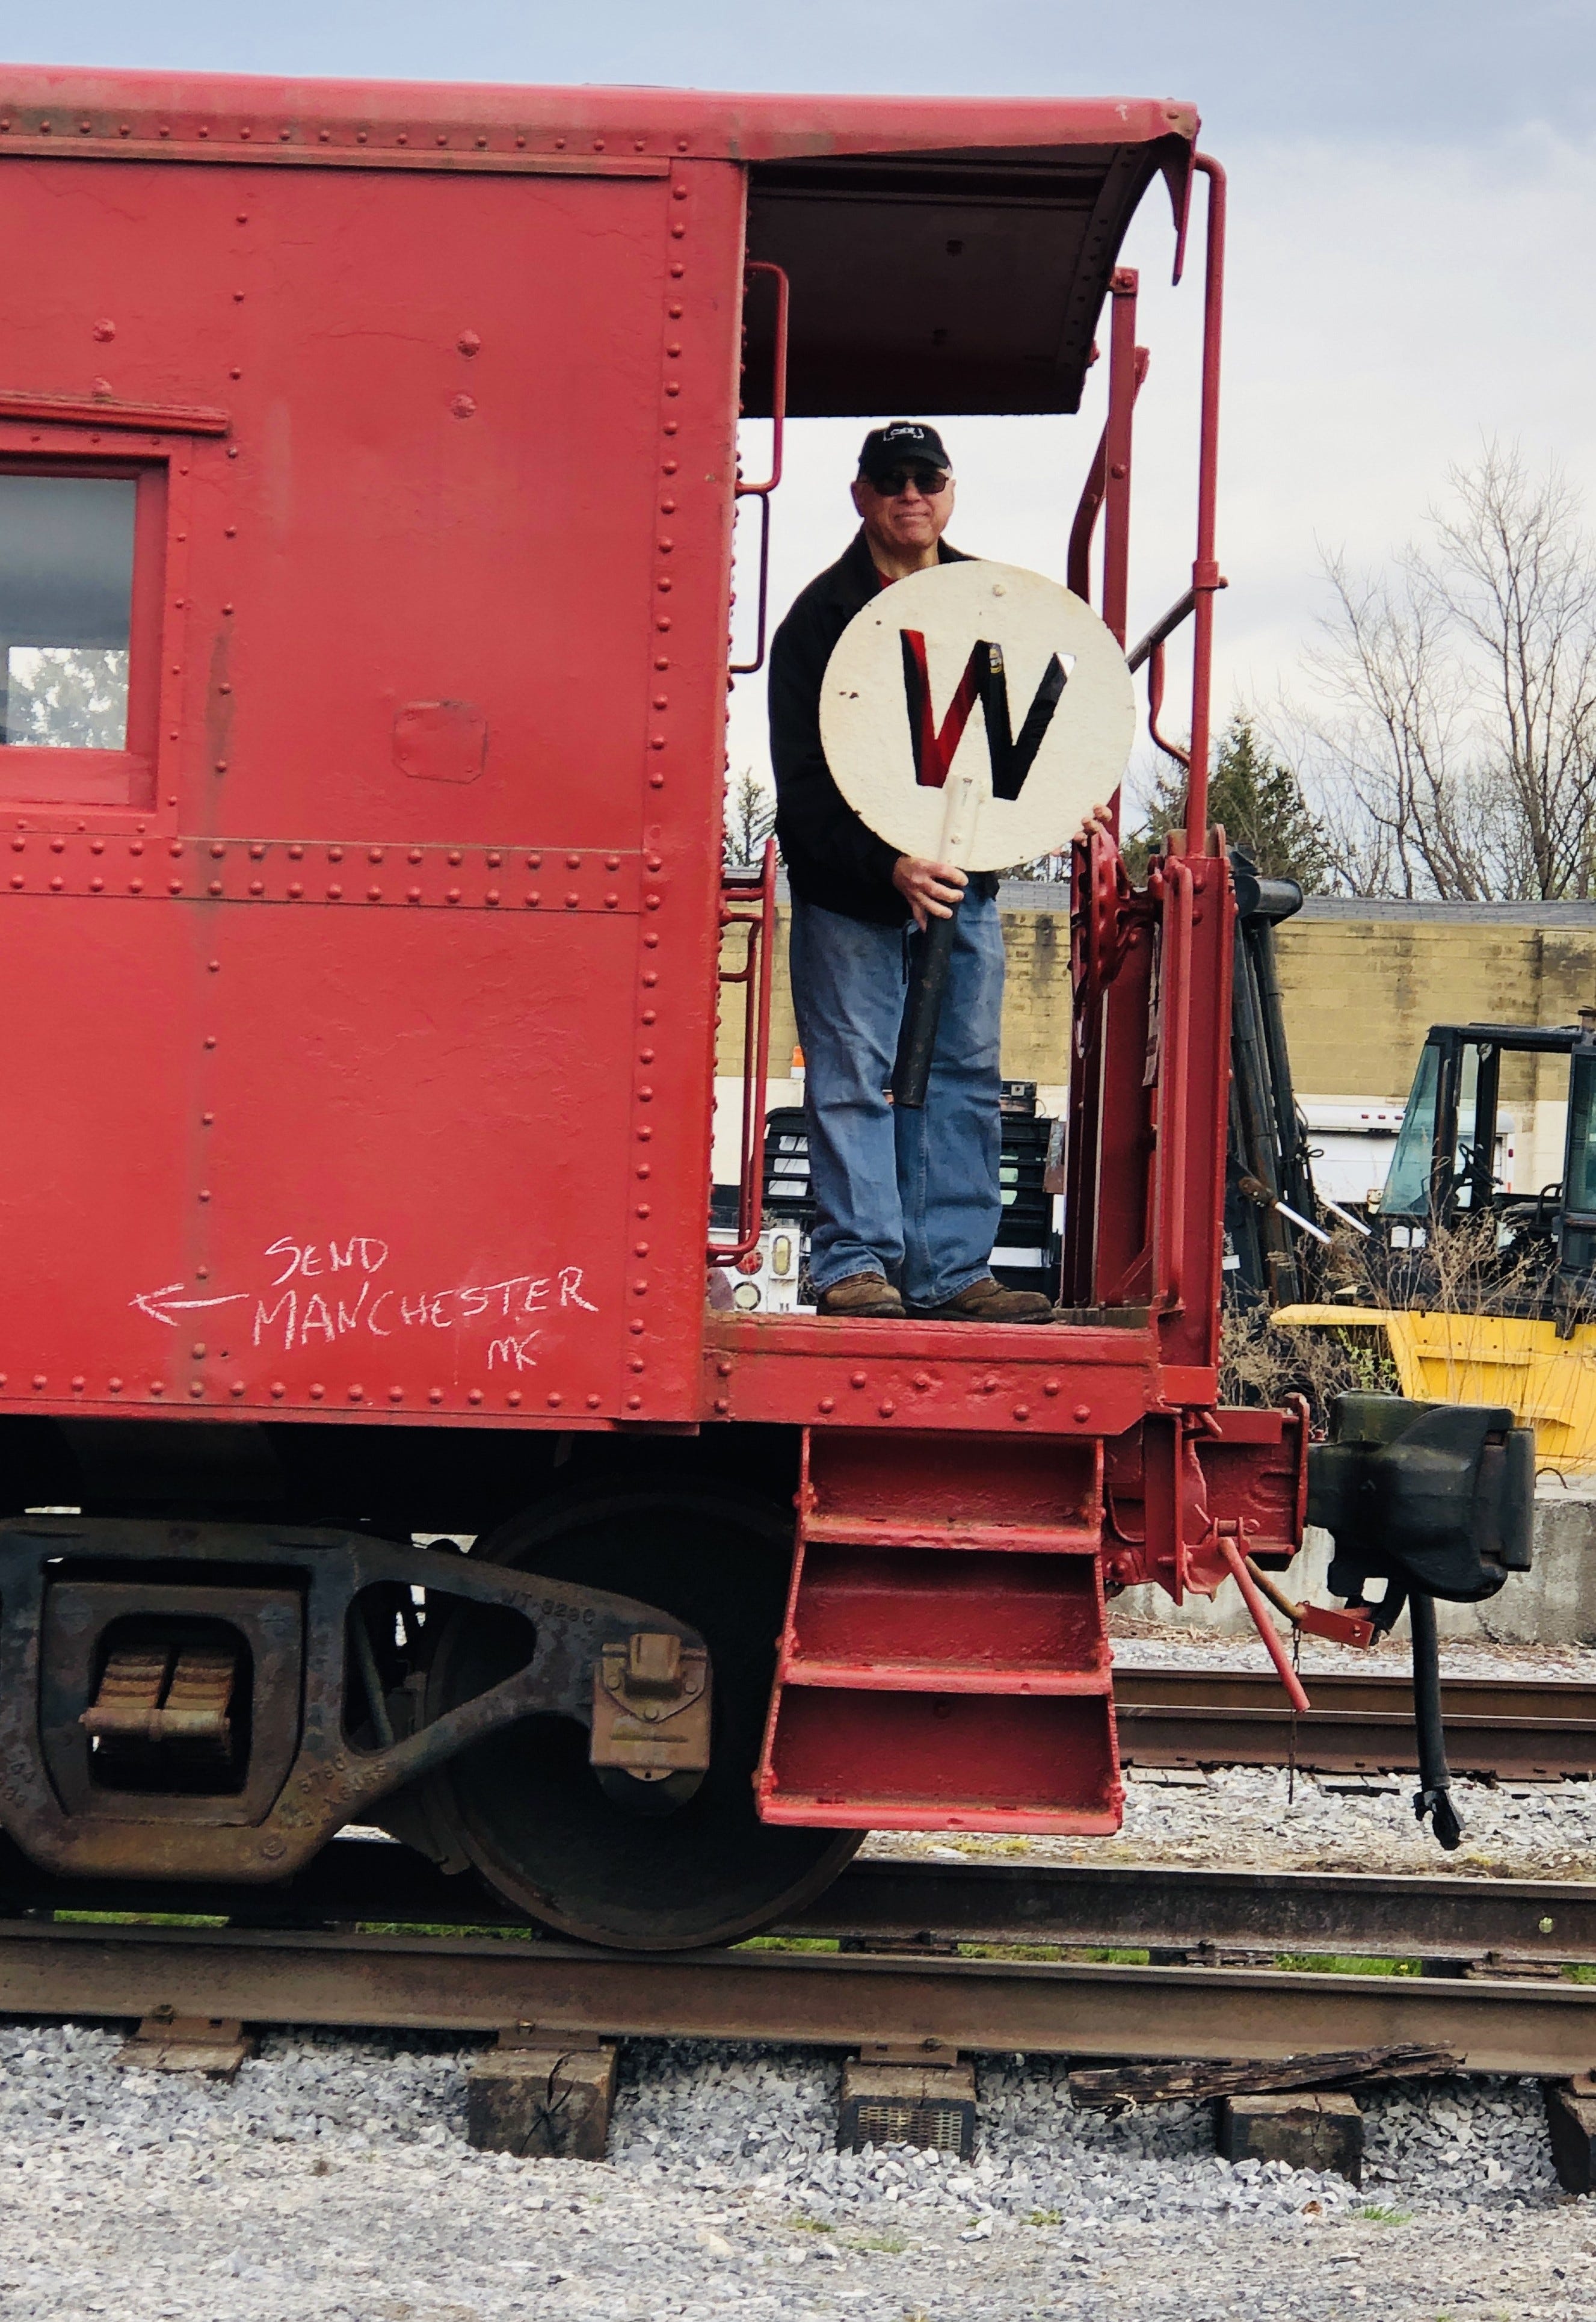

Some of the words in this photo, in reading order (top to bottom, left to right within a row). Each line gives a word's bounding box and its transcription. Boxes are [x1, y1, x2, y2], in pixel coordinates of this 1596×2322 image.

[899, 629, 1076, 801] W
[265, 1237, 388, 1285] SEND
[253, 1267, 599, 1349] MANCHESTER
